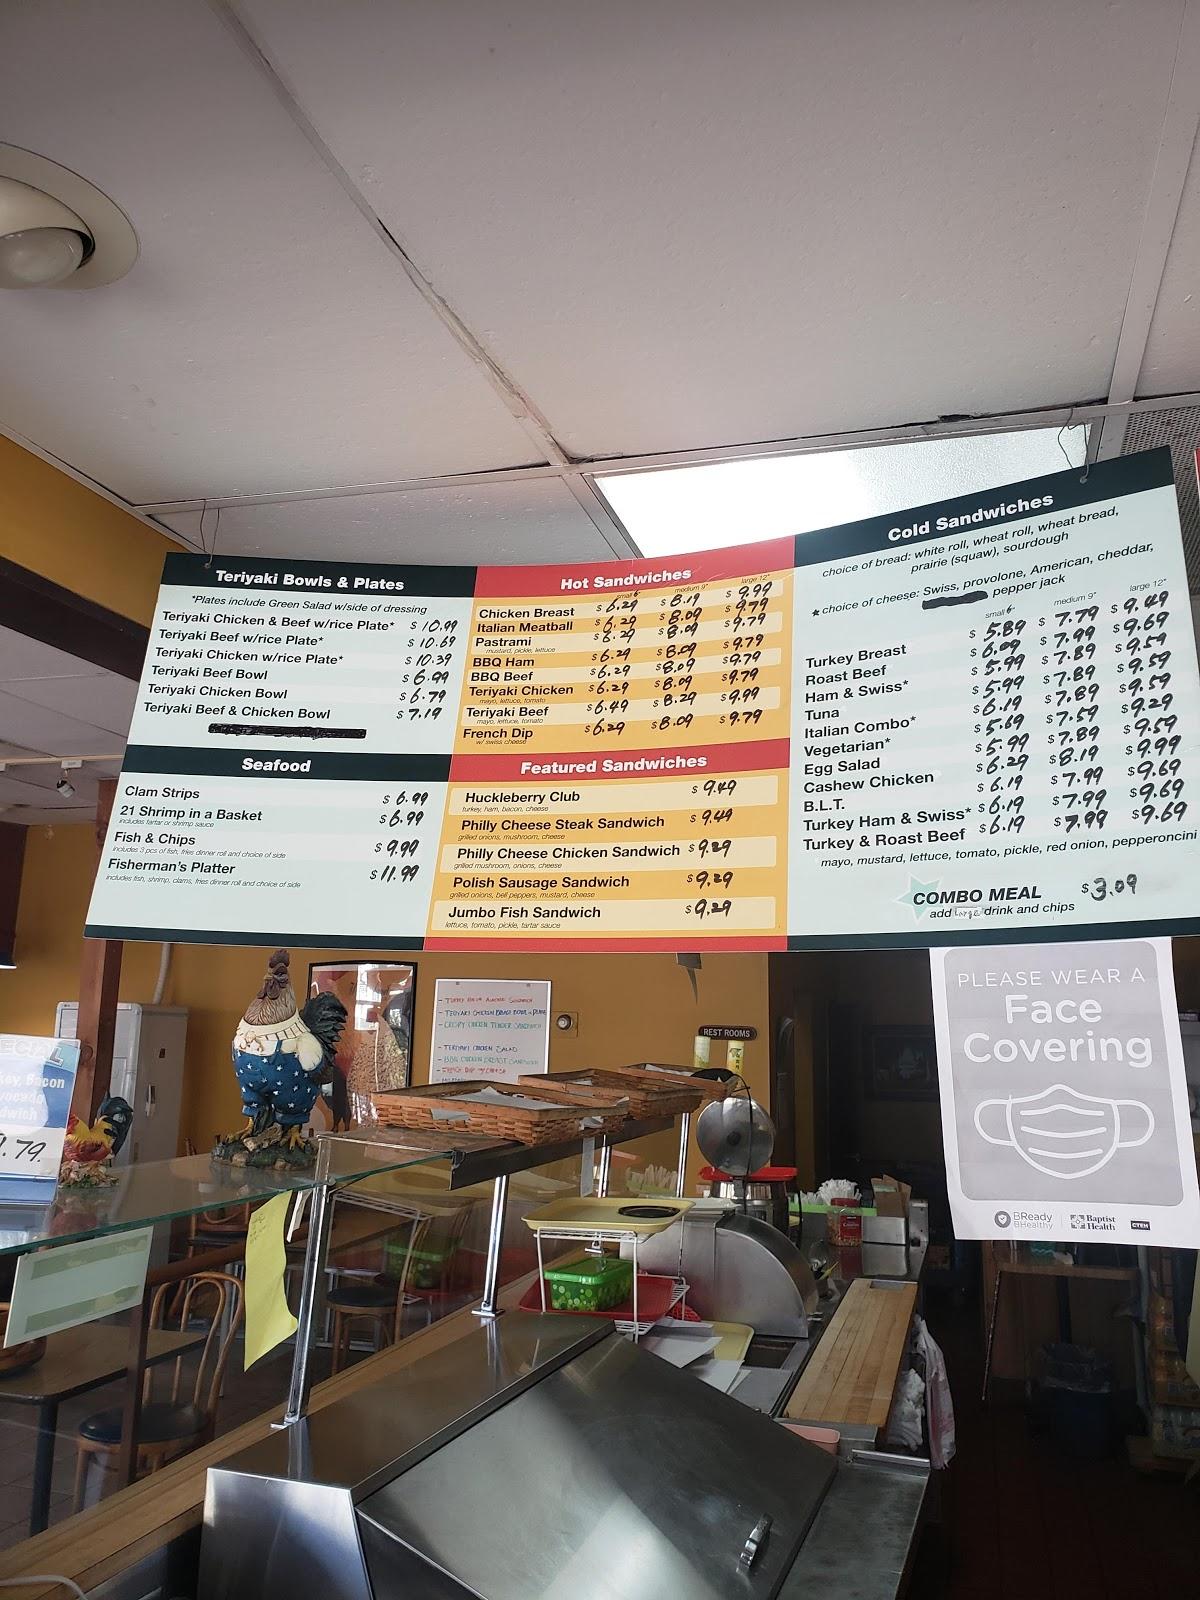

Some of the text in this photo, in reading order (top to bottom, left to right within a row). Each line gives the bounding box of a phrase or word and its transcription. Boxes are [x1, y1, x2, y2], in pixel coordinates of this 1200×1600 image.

[888, 494, 1054, 541] Cold Sandwiches
[822, 506, 1119, 577] choice bread: white roll, wheat bread,
[911, 529, 1069, 574] prairie (squaw), sourdough
[216, 570, 404, 590] Teriyaki Bowls Plates
[561, 570, 691, 590] Hot Sandwiches
[822, 543, 1153, 614] choice cheese: Swiss, provolone, American, cheddar,
[992, 574, 1065, 598] pepper jack
[228, 597, 266, 607] include
[383, 604, 428, 615] dressing
[479, 609, 530, 619] Chicken
[163, 611, 210, 624] Teriyaki
[213, 614, 264, 625] Chicken
[281, 617, 311, 627] Beef
[519, 621, 573, 632] Meatball
[159, 629, 240, 642] Teriyaki Beef
[476, 637, 532, 647] Pastrami
[156, 647, 301, 663] Teriyaki Chicken w/rice
[473, 657, 534, 667] BBQ Ham
[805, 644, 906, 668] Turkey Breast
[152, 665, 268, 680] Teriyaki Beef Bowl
[471, 671, 533, 682] BBQ Beef
[806, 664, 886, 686] Roast Beef
[148, 683, 288, 699] Teriyaki Chicken Bowl
[469, 685, 573, 698] Teriyaki Chicken
[806, 692, 838, 703] Ham
[144, 702, 330, 719] Teriyaki Beef Chicken Bowl
[466, 706, 549, 719] Teriyaki Beef
[805, 709, 839, 721] Tuna
[463, 728, 533, 740] French Dip
[805, 725, 849, 739] Italian
[242, 758, 311, 772] Seafood
[521, 756, 707, 774] Featured Sandwiches
[804, 757, 880, 777] Egg Salad
[804, 773, 934, 793] Cashew Chicken
[125, 785, 200, 800] Clam Strips
[465, 791, 580, 804] Huckleberry Club
[120, 805, 262, 821] 21 Shrimp Basket
[804, 798, 845, 812] B.L.T.
[462, 816, 664, 833] Philly Cheese Steak Sandwich
[803, 818, 854, 831] Turkey
[859, 815, 895, 827] Ham
[114, 831, 195, 847] Fish Chips
[803, 828, 966, 851] Turkey Roast Beef
[857, 853, 906, 865] mustard,
[909, 850, 951, 862] lettuce,
[956, 848, 1000, 859] tomato,
[1003, 844, 1042, 858] pickle,
[1046, 841, 1067, 852] red
[1070, 839, 1108, 850] onion,
[1112, 829, 1197, 849] pepperoncini
[457, 845, 680, 861] Philly Cheese Chicken Sandwich
[108, 858, 236, 874] Fisherman's Platter
[453, 876, 629, 890] Polish Sausage Sandwich
[913, 886, 1042, 905] COMBO MEAL
[448, 906, 600, 918] Jumbo Fish Sandwich
[984, 905, 1013, 916] drink
[1042, 902, 1075, 914] chips
[958, 967, 1146, 987] PLEASE WEAR A
[1005, 994, 1102, 1024] Face
[704, 1028, 750, 1038] REST ROOMS
[964, 1030, 1152, 1068] Covering
[1013, 1212, 1052, 1223] BReady
[1086, 1214, 1116, 1224] Baptist
[1087, 1222, 1115, 1230] Health
